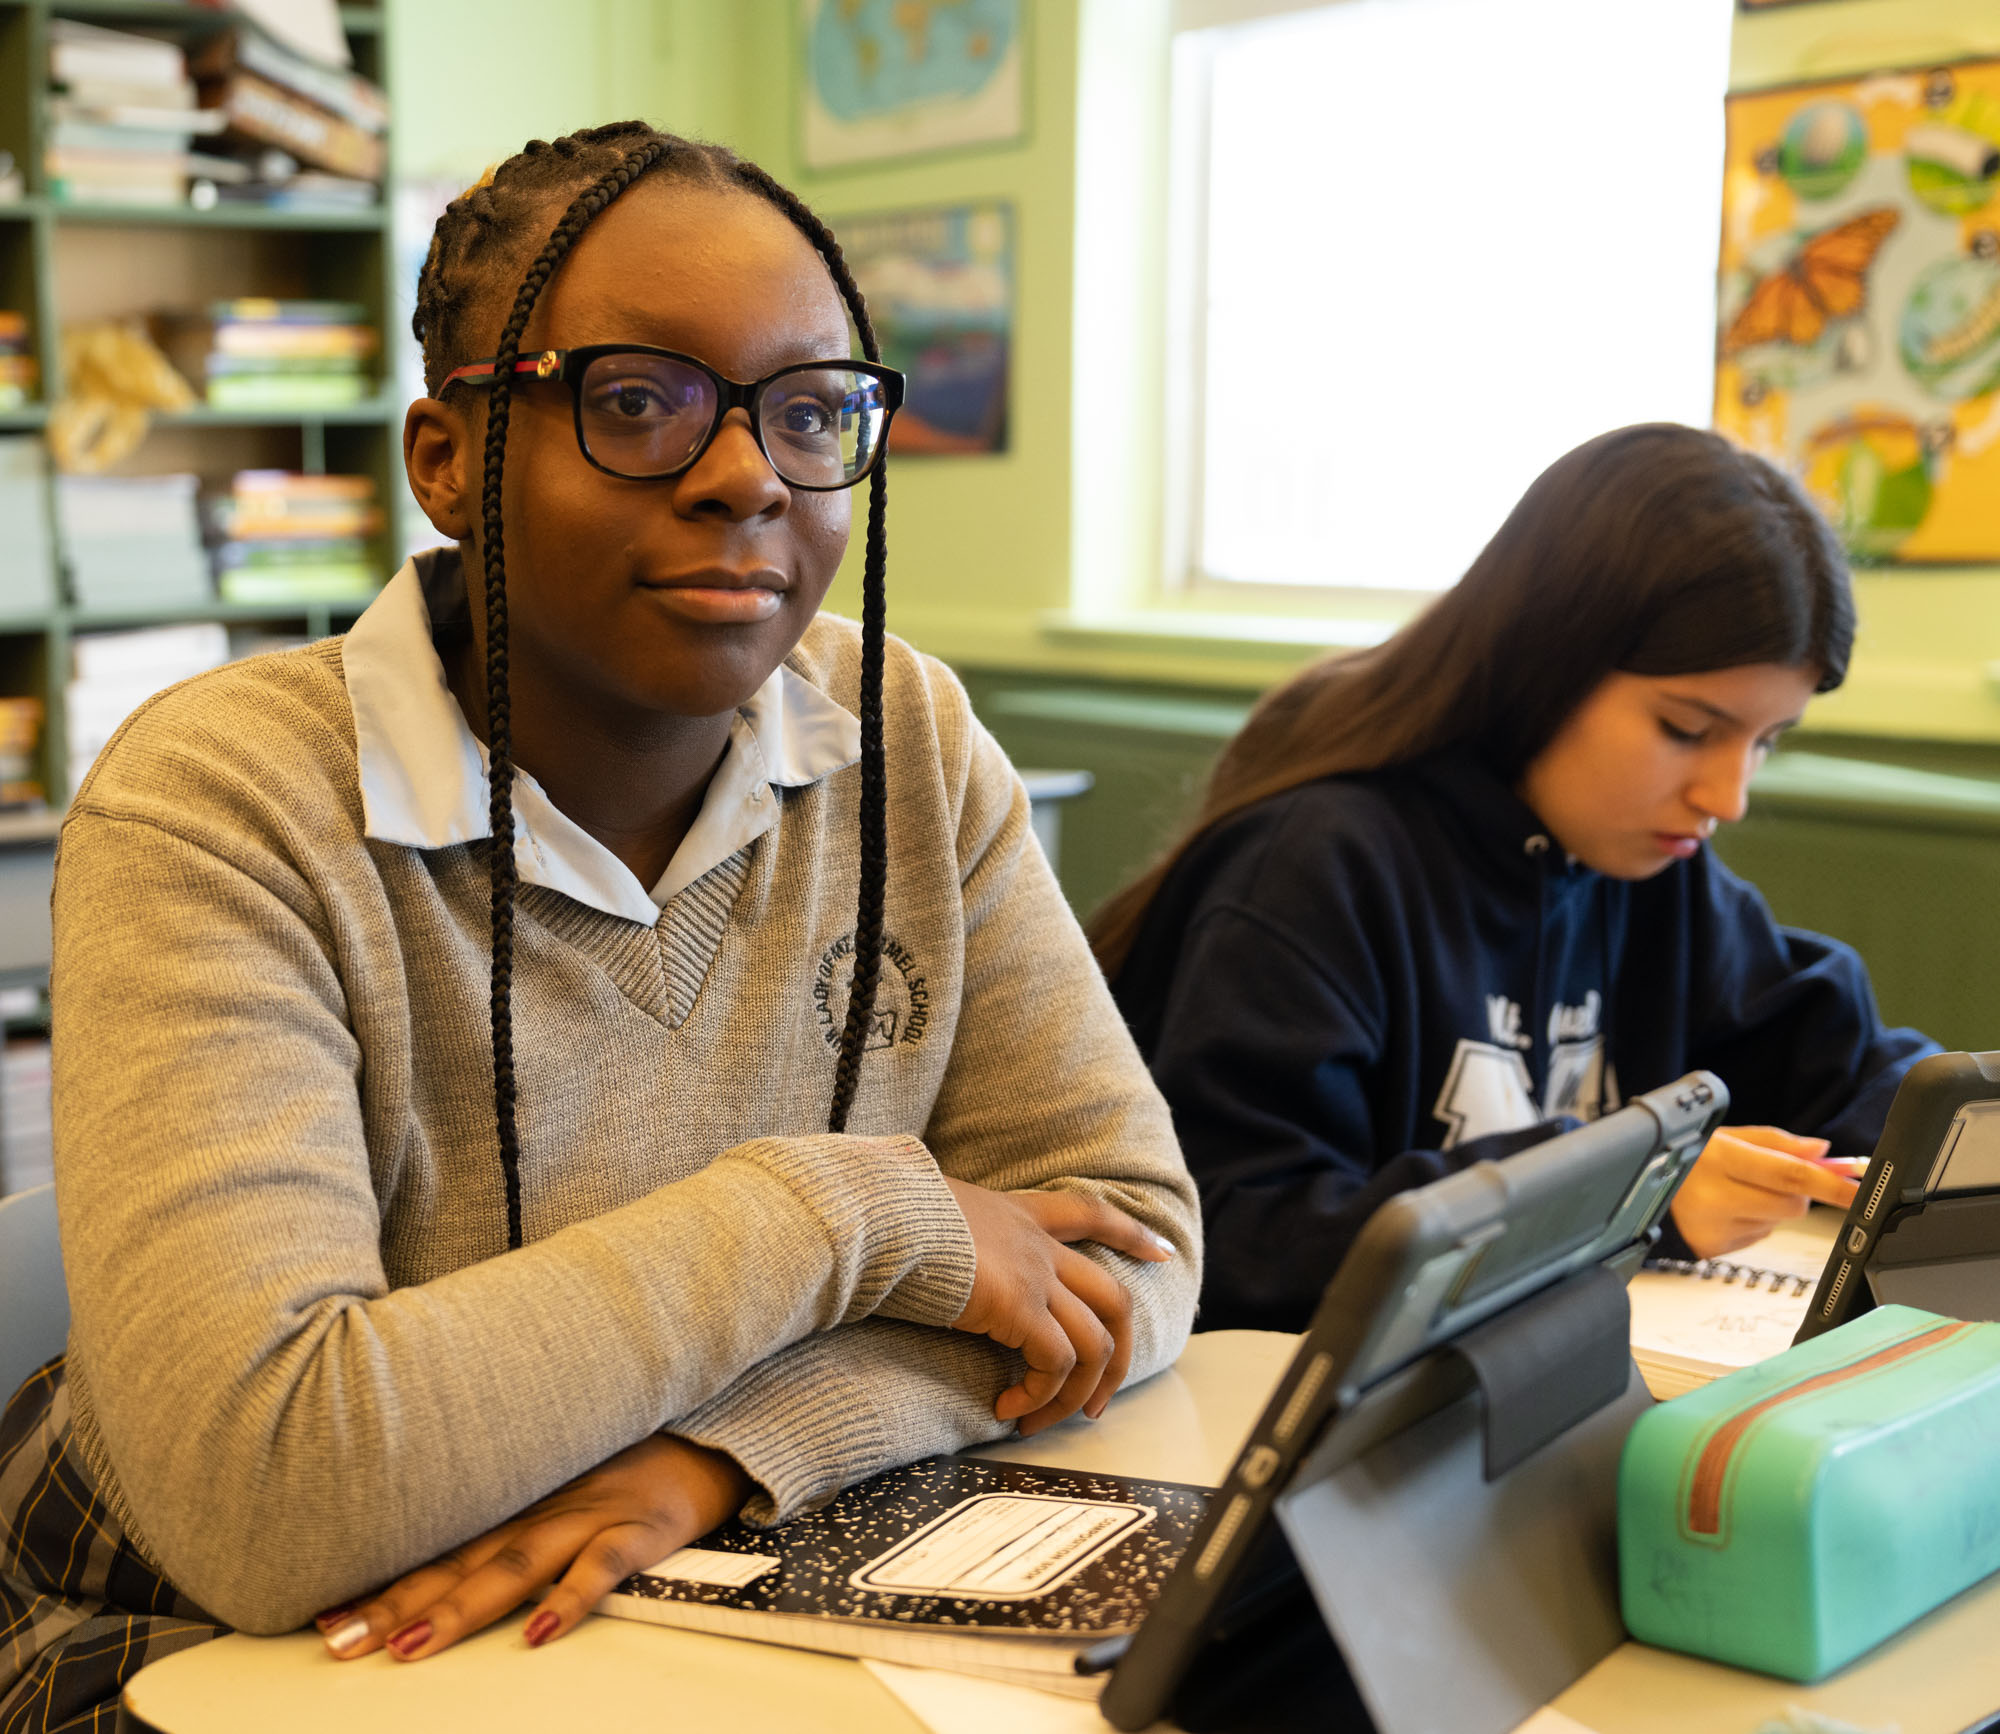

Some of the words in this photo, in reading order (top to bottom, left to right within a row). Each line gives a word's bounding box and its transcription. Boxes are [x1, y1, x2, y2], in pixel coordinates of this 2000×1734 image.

[818, 951, 834, 979] OF
[813, 976, 833, 1025] LADY
[900, 977, 929, 1045] SCHOOL
[1050, 1516, 1118, 1560] COMPOSITION
[1024, 1560, 1055, 1580] BOOK
